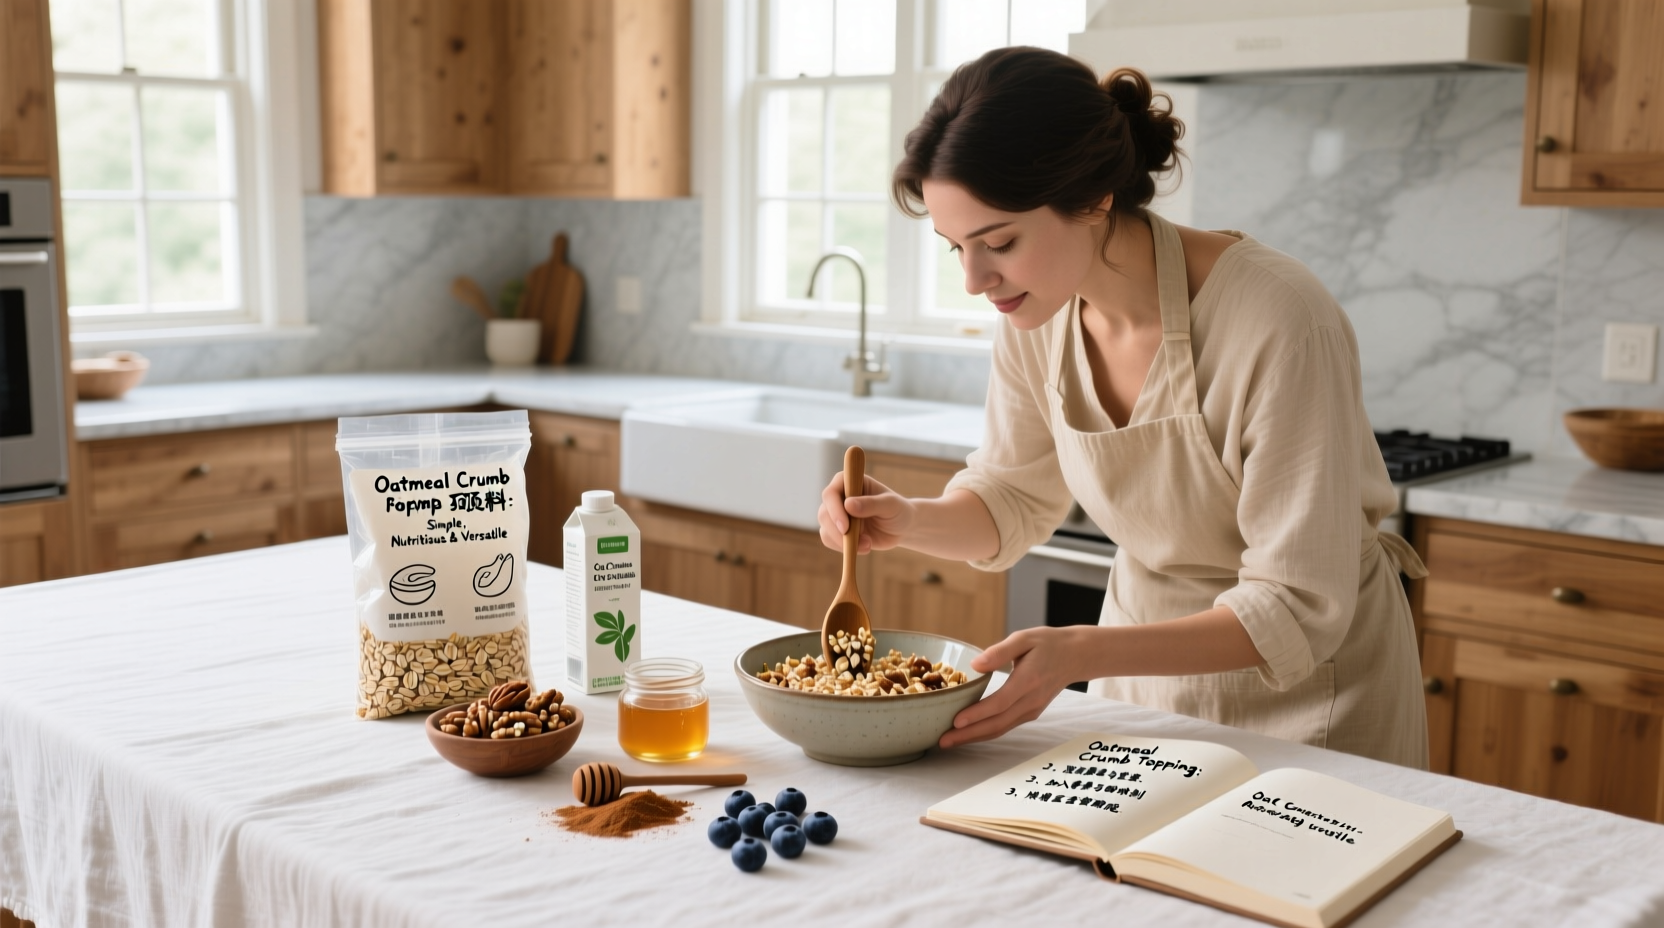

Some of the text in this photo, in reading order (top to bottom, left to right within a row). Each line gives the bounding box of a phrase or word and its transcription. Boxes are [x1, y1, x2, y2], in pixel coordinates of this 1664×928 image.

[374, 467, 510, 494] Oatmeal Crumb
[426, 517, 467, 533] Simple,
[1088, 740, 1159, 755] Oatmeal
[1078, 751, 1131, 765] Crumb
[1138, 756, 1203, 778] Topping:
